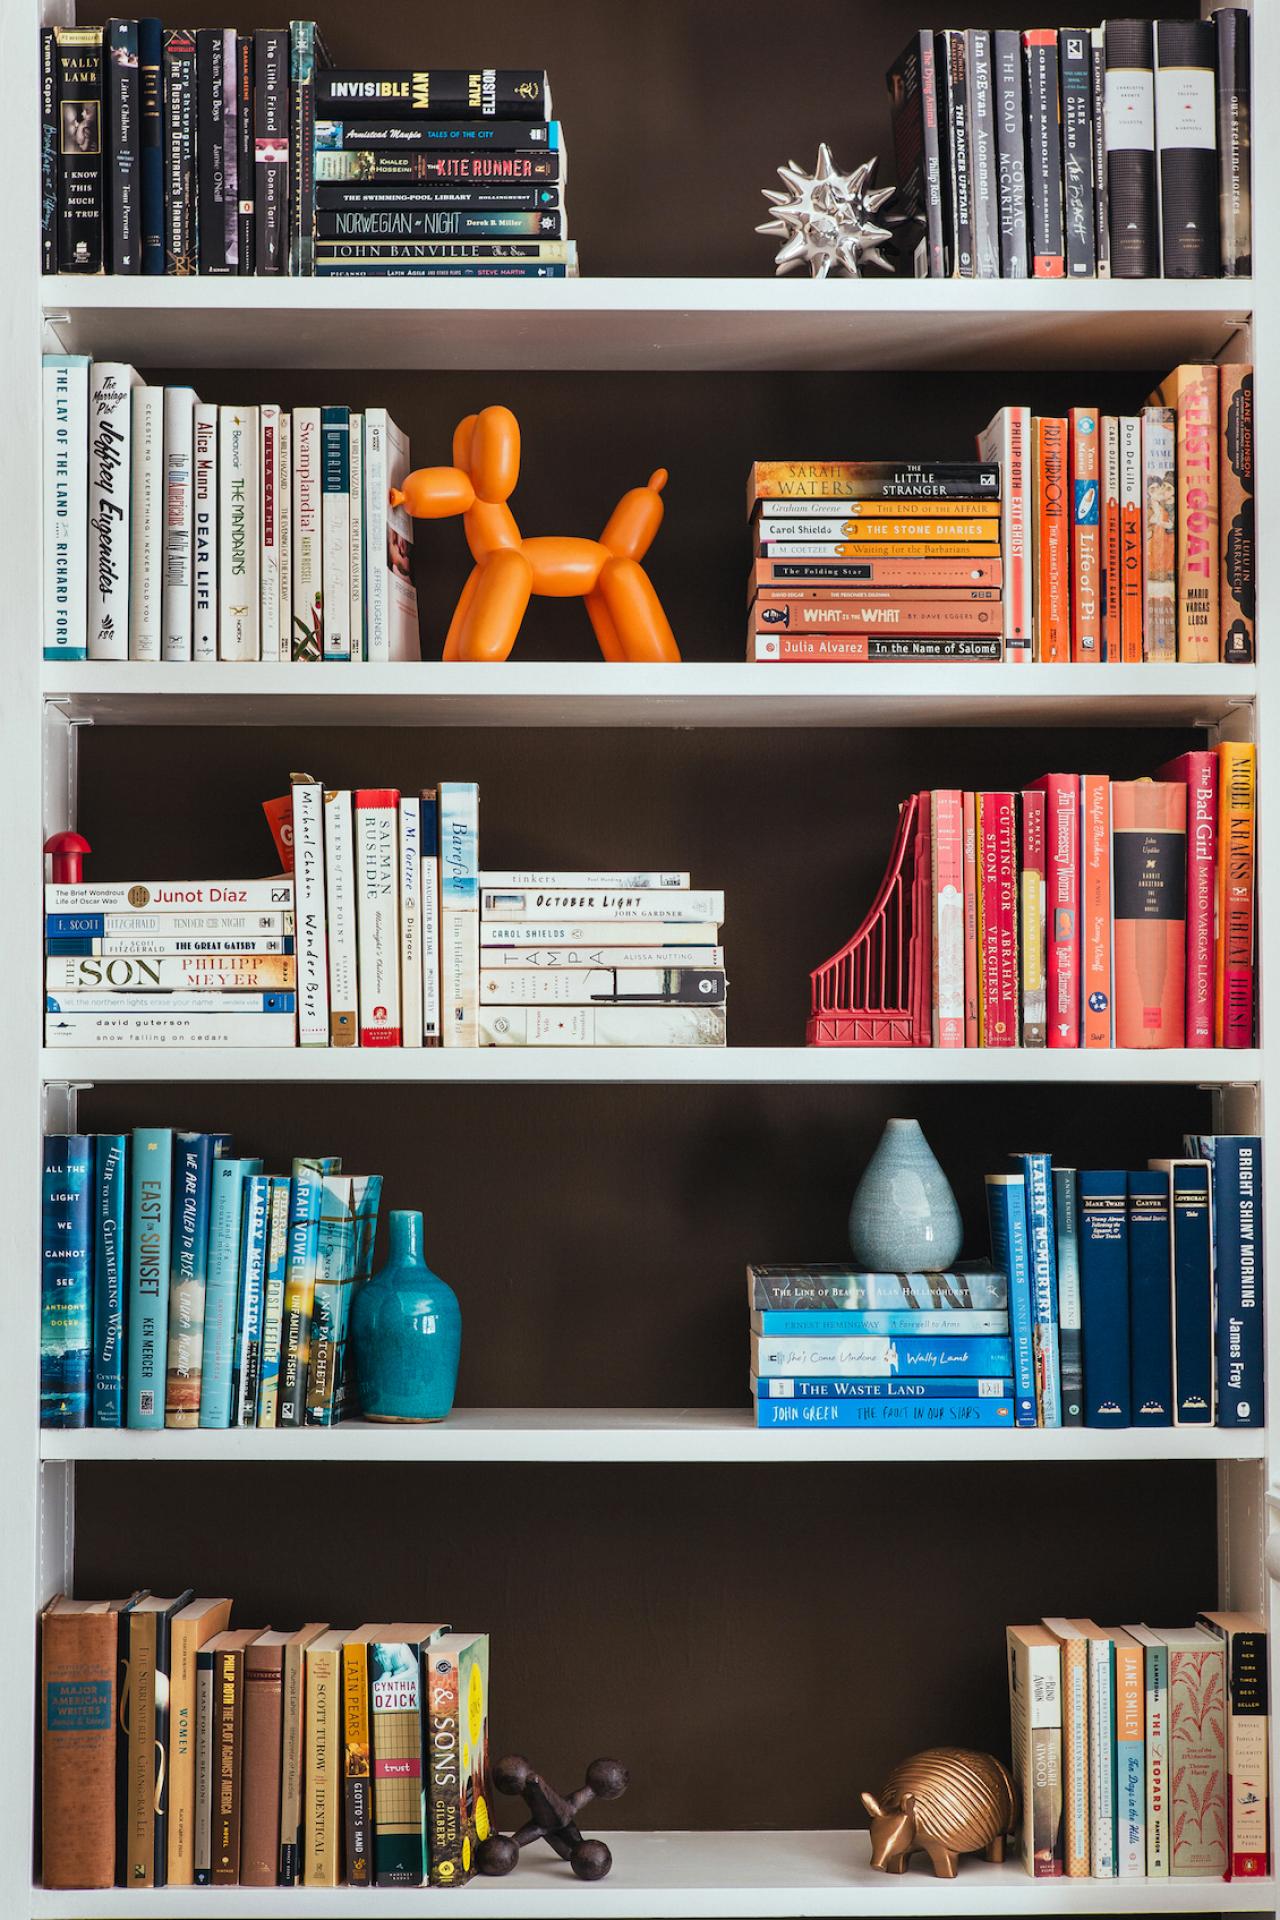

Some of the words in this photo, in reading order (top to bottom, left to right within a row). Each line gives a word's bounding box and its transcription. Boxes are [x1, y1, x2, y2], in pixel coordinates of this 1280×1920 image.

[61, 58, 99, 68] WALLY
[267, 40, 276, 59] The
[975, 36, 985, 57] Ian
[64, 72, 96, 83] LAMB
[172, 61, 181, 81] THE
[267, 64, 276, 91] Little
[1003, 54, 1014, 84] THE
[44, 78, 52, 114] Capote
[172, 84, 182, 127] RUSSIAN
[331, 82, 410, 97] INVISIBLE
[412, 72, 429, 109] MAN
[469, 74, 481, 107] RALPH
[483, 69, 496, 114] ELLISON
[267, 96, 277, 131] Friend
[1005, 91, 1015, 133] ROAD
[172, 132, 182, 195] DEBUTANTE'S
[437, 159, 469, 176] KITE
[473, 159, 531, 176] RUNNER
[979, 130, 989, 200] Atonement
[268, 170, 276, 200] Donna
[1000, 153, 1013, 236] McCARTHY
[1013, 161, 1023, 228] CORMAC
[172, 201, 182, 253] HANDBOOK
[268, 207, 276, 228] Tartt
[57, 369, 67, 392] THE
[57, 399, 67, 422] LAY
[57, 429, 67, 445] OF
[197, 423, 213, 453] Alice
[1011, 422, 1022, 456] PHILIP
[1126, 424, 1135, 445] Don
[57, 453, 67, 476] THE
[94, 421, 124, 494] Jeffrey
[1126, 451, 1135, 492] DeLillo
[198, 460, 213, 500] Munro
[296, 422, 315, 532] Swamplandia!
[883, 486, 947, 496] STRANGER
[895, 474, 934, 484] LITTLE
[1012, 462, 1022, 488] ROTH
[57, 483, 67, 517] LAND
[1012, 497, 1023, 521] EXIT
[198, 513, 208, 562] DEAR
[867, 526, 887, 534] THE
[894, 526, 930, 534] STONE
[936, 526, 982, 534] DIARIES
[1012, 524, 1023, 558] GHOST
[1079, 532, 1094, 571] Life
[57, 543, 67, 603] RICHARD
[1080, 575, 1094, 592] of
[198, 572, 208, 609] LIFE
[57, 610, 67, 645] FORD
[1080, 602, 1095, 620] Pi
[785, 641, 813, 652] Julia
[819, 642, 863, 652] Alvarez
[876, 644, 888, 652] In
[891, 644, 908, 653] the
[913, 644, 940, 653] Name
[944, 644, 955, 653] of
[959, 643, 996, 654] Salomé
[1201, 767, 1211, 785] The
[302, 792, 315, 844] Michael
[1195, 789, 1212, 821] Bad
[446, 823, 469, 890] Barefoot
[1000, 806, 1010, 875] CUTTING
[1195, 824, 1212, 860] Girl
[304, 851, 315, 898] Chabon
[366, 818, 377, 899] RUSHDIE
[380, 821, 391, 895] SALMAN
[987, 834, 997, 883] STONE
[154, 889, 202, 904] Junot
[210, 887, 248, 902] Díaz
[537, 895, 594, 907] OCTOBER
[603, 895, 641, 908] LIGHT
[1001, 882, 1011, 911] FOR
[1198, 866, 1208, 908] MARIO
[176, 942, 191, 950] THE
[195, 942, 221, 950] GREAT
[224, 941, 256, 950] GATSBY
[306, 914, 316, 975] Wonder
[1198, 913, 1208, 960] VARGAS
[66, 959, 75, 985] THE
[79, 959, 166, 986] SON
[182, 959, 263, 970] PHILIPP
[187, 975, 258, 985] MEYER
[988, 927, 998, 1004] VERGHESE
[1002, 929, 1011, 1001] ABRAHAM
[306, 983, 318, 1016] Boys
[1198, 965, 1207, 1003] LLOSA
[45, 1165, 65, 1173] ALL
[68, 1165, 85, 1173] THE
[1239, 1148, 1253, 1196] BRIGHT
[141, 1181, 161, 1223] EAST
[296, 1167, 310, 1217] SARAH
[1240, 1201, 1254, 1240] SHINY
[140, 1233, 160, 1297] SUNSET
[292, 1223, 307, 1282] VOWELL
[1241, 1244, 1255, 1307] MORNING
[143, 1318, 154, 1336] KEN
[288, 1295, 300, 1350] UNFAMILIAR
[1229, 1318, 1243, 1357] James
[142, 1340, 154, 1377] MERCER
[286, 1354, 299, 1387] FISHES
[907, 1353, 937, 1366] Wally
[940, 1354, 968, 1364] Lamb
[1228, 1362, 1244, 1388] Frey
[800, 1383, 828, 1395] THE
[834, 1383, 880, 1395] WASTE
[887, 1383, 924, 1395] LAND
[773, 1406, 798, 1422] JOHN
[803, 1407, 838, 1422] GREEN
[223, 1655, 235, 1682] PHILIP
[348, 1660, 358, 1693] IAIN
[1125, 1658, 1137, 1687] JANE
[223, 1683, 234, 1704] ROTH
[373, 1682, 417, 1691] CYNTHIA
[375, 1694, 417, 1707] OZICK
[434, 1687, 454, 1704] &
[223, 1706, 234, 1721] THE
[316, 1684, 325, 1724] SCOTT
[348, 1698, 359, 1736] PEARS
[1126, 1692, 1138, 1735] SMILEY
[179, 1708, 188, 1755] WOMEN
[222, 1723, 234, 1743] PLOT
[222, 1745, 233, 1777] AGAINST
[316, 1729, 325, 1772] TUROW
[434, 1717, 456, 1785] SONS
[385, 1763, 410, 1772] trust
[221, 1780, 232, 1814] AMERICA
[354, 1783, 362, 1826] GIOTTO'S
[315, 1789, 325, 1855] IDENTICAL
[436, 1801, 447, 1846] GILBERT
[447, 1807, 456, 1840] DAVID
[355, 1832, 363, 1852] HAND
